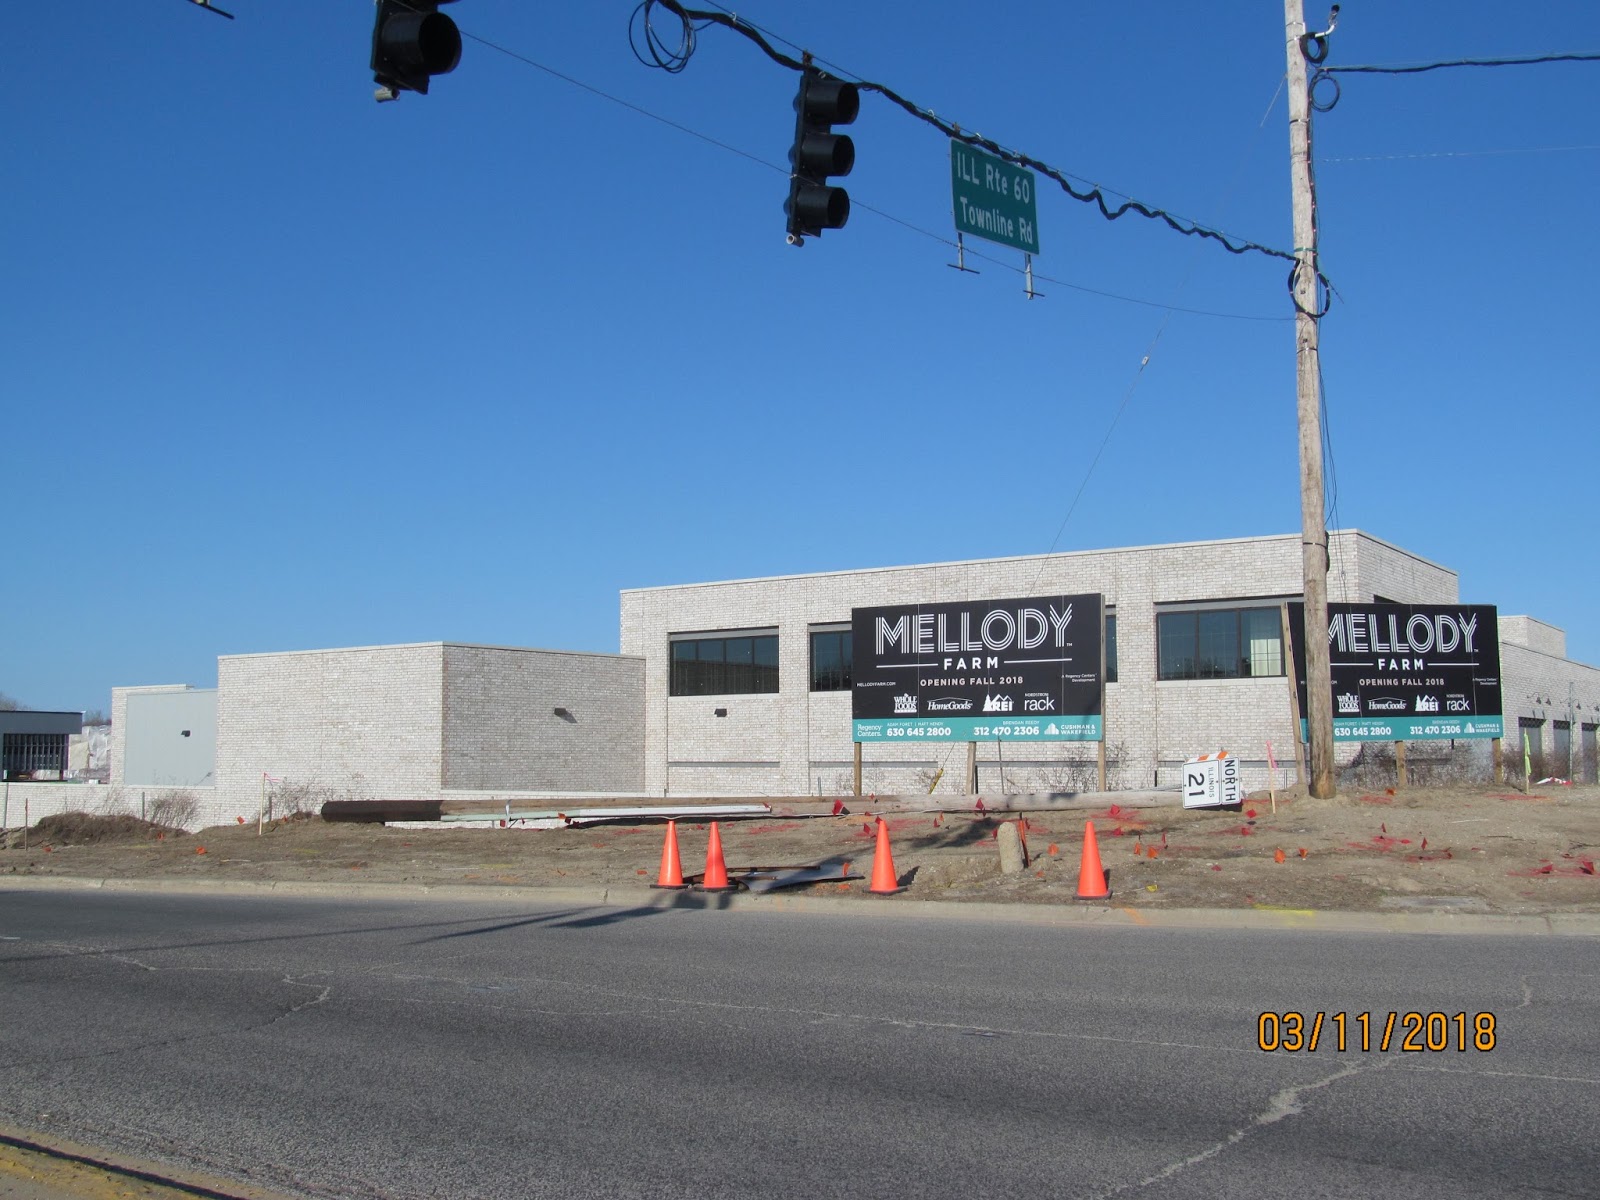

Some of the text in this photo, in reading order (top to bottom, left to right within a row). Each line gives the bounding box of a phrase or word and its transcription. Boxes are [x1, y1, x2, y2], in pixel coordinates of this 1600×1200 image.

[957, 152, 1030, 204] ILL Rte 60
[960, 196, 1033, 244] Townline Rd
[875, 603, 1072, 655] MELLODY
[943, 656, 999, 671] FARM
[1377, 658, 1424, 671] FARM
[920, 676, 1024, 687] OPENING FALL 2018
[1359, 678, 1445, 686] OPENING FALL 2018
[893, 695, 918, 703] WHOLE
[1024, 696, 1055, 711] rack
[1337, 695, 1359, 703] WHOLE
[1446, 697, 1470, 711] rack
[894, 702, 917, 710] FOODS
[927, 700, 972, 711] HomeGoods
[995, 700, 1013, 712] REI
[1368, 700, 1406, 710] HomeGoods
[1426, 701, 1439, 712] REI
[857, 723, 882, 732] Regency
[886, 727, 952, 737] 630 645 2800
[973, 726, 1040, 736] 312 470 2306
[1334, 726, 1392, 736] 630 645 2800
[1409, 725, 1461, 735] 312 470 2306
[1188, 772, 1205, 797] 21
[1224, 759, 1236, 801] NORTH
